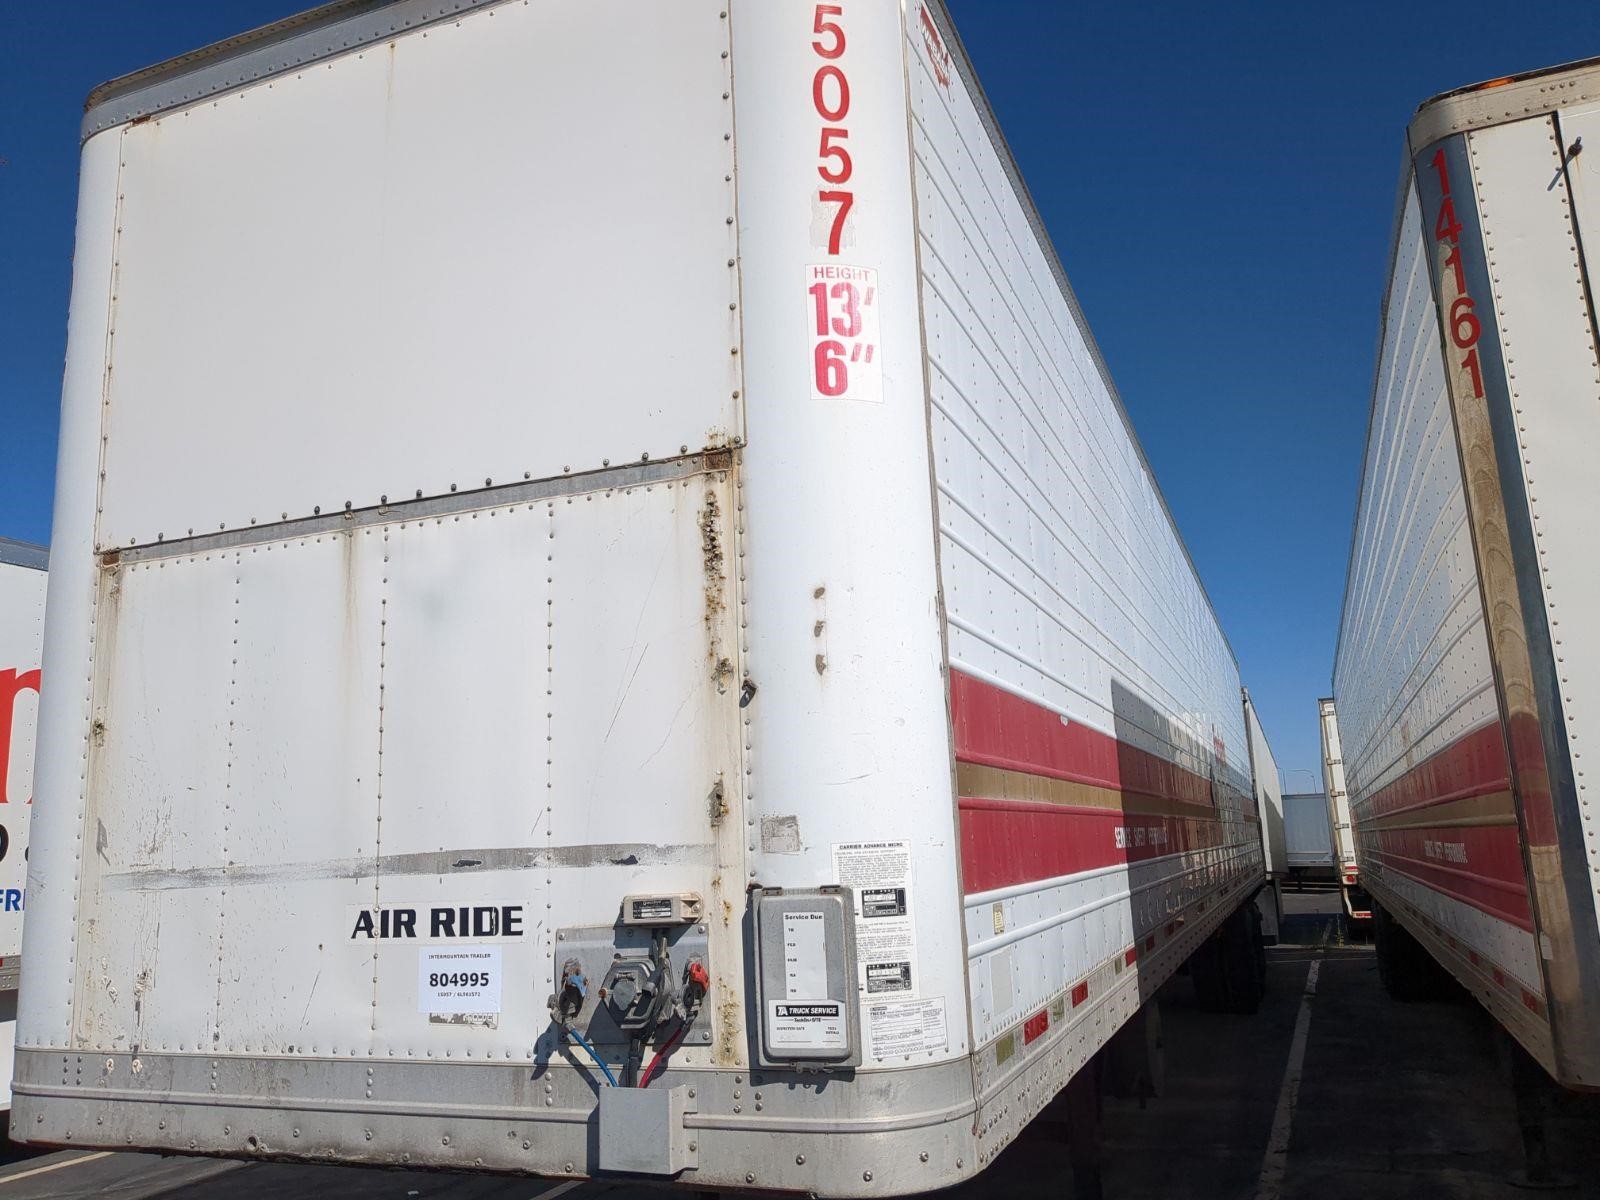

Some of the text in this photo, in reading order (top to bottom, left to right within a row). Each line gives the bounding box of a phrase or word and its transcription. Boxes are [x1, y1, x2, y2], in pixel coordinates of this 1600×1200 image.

[814, 267, 870, 282] HEIGHT
[1430, 148, 1483, 399] 14161
[808, 282, 875, 338] 13'
[351, 906, 524, 940] AIR RIDE
[429, 972, 490, 987] 804995
